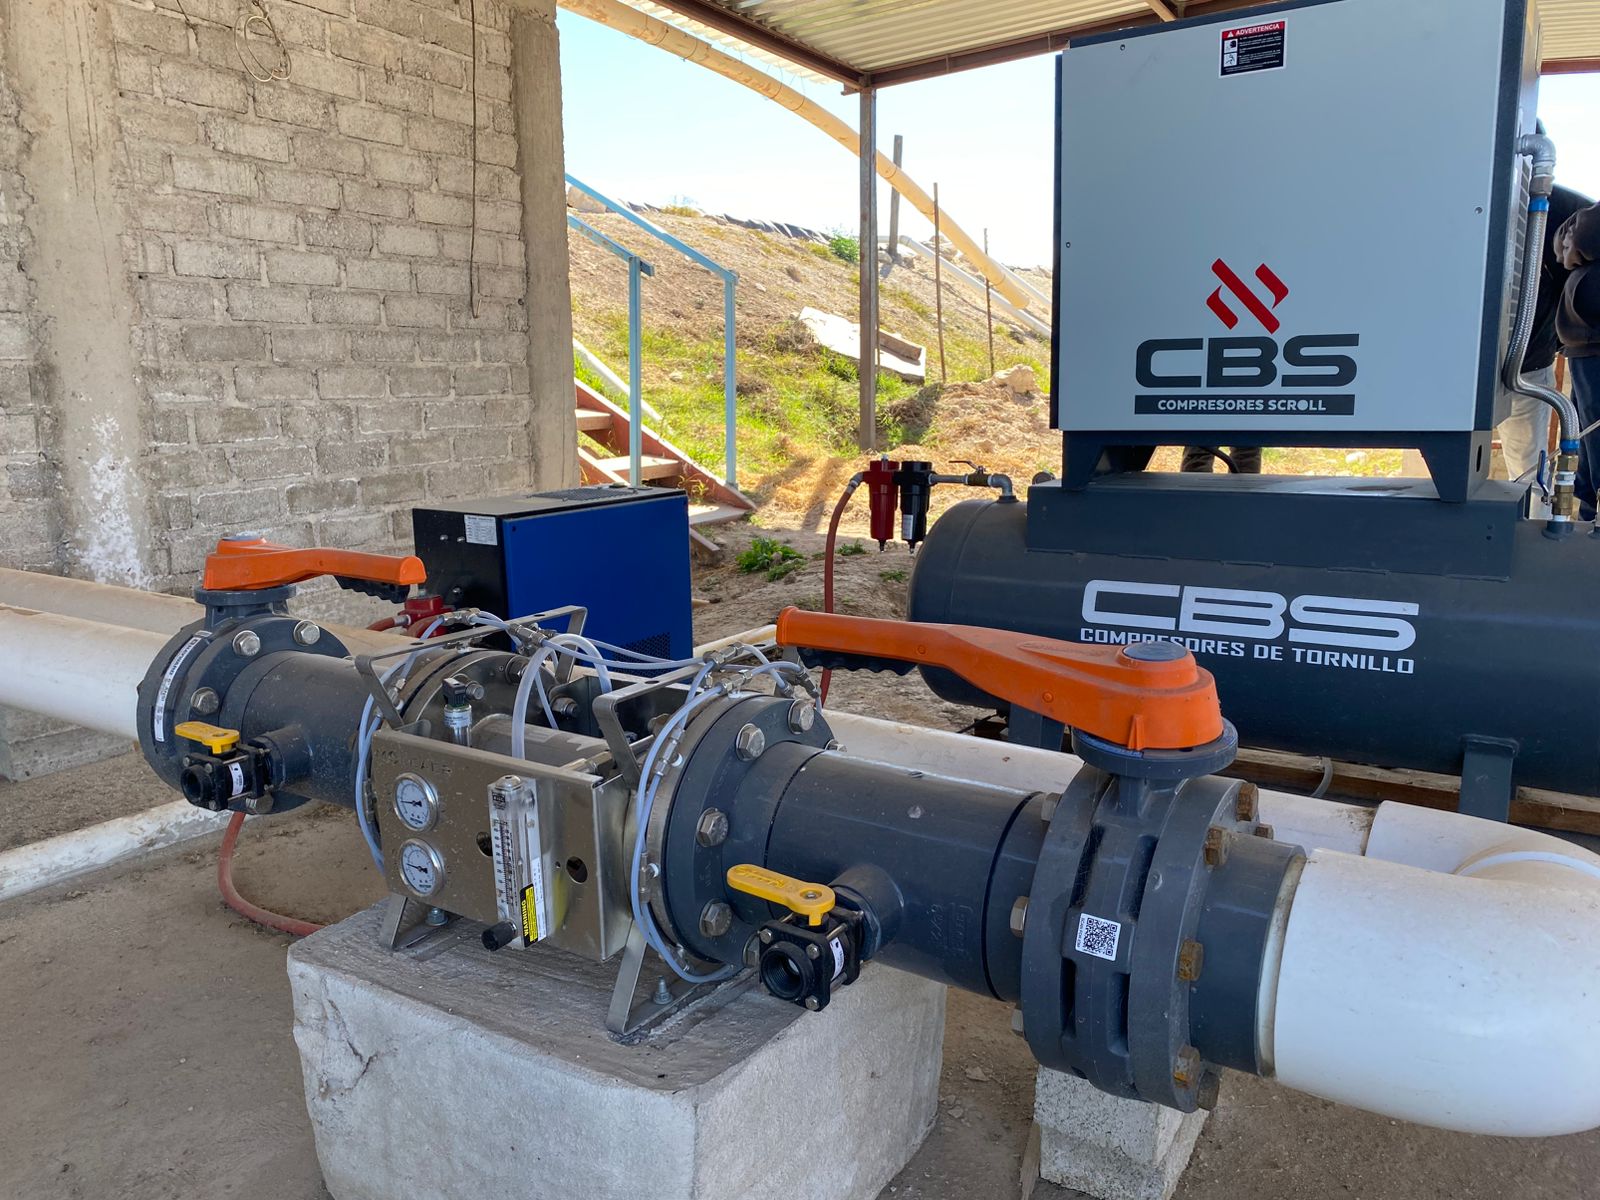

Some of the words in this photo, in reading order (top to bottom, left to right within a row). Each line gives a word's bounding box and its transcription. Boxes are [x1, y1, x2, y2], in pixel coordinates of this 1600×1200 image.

[1235, 23, 1280, 36] ADVERTENCIA
[1135, 333, 1360, 388] CBS
[1157, 399, 1264, 411] COMPRESORES
[1268, 399, 1326, 411] SCROLL
[1081, 579, 1420, 651] CBS
[1253, 644, 1284, 661] DE
[1292, 647, 1415, 674] TORNILLO
[521, 900, 529, 937] WARNING
